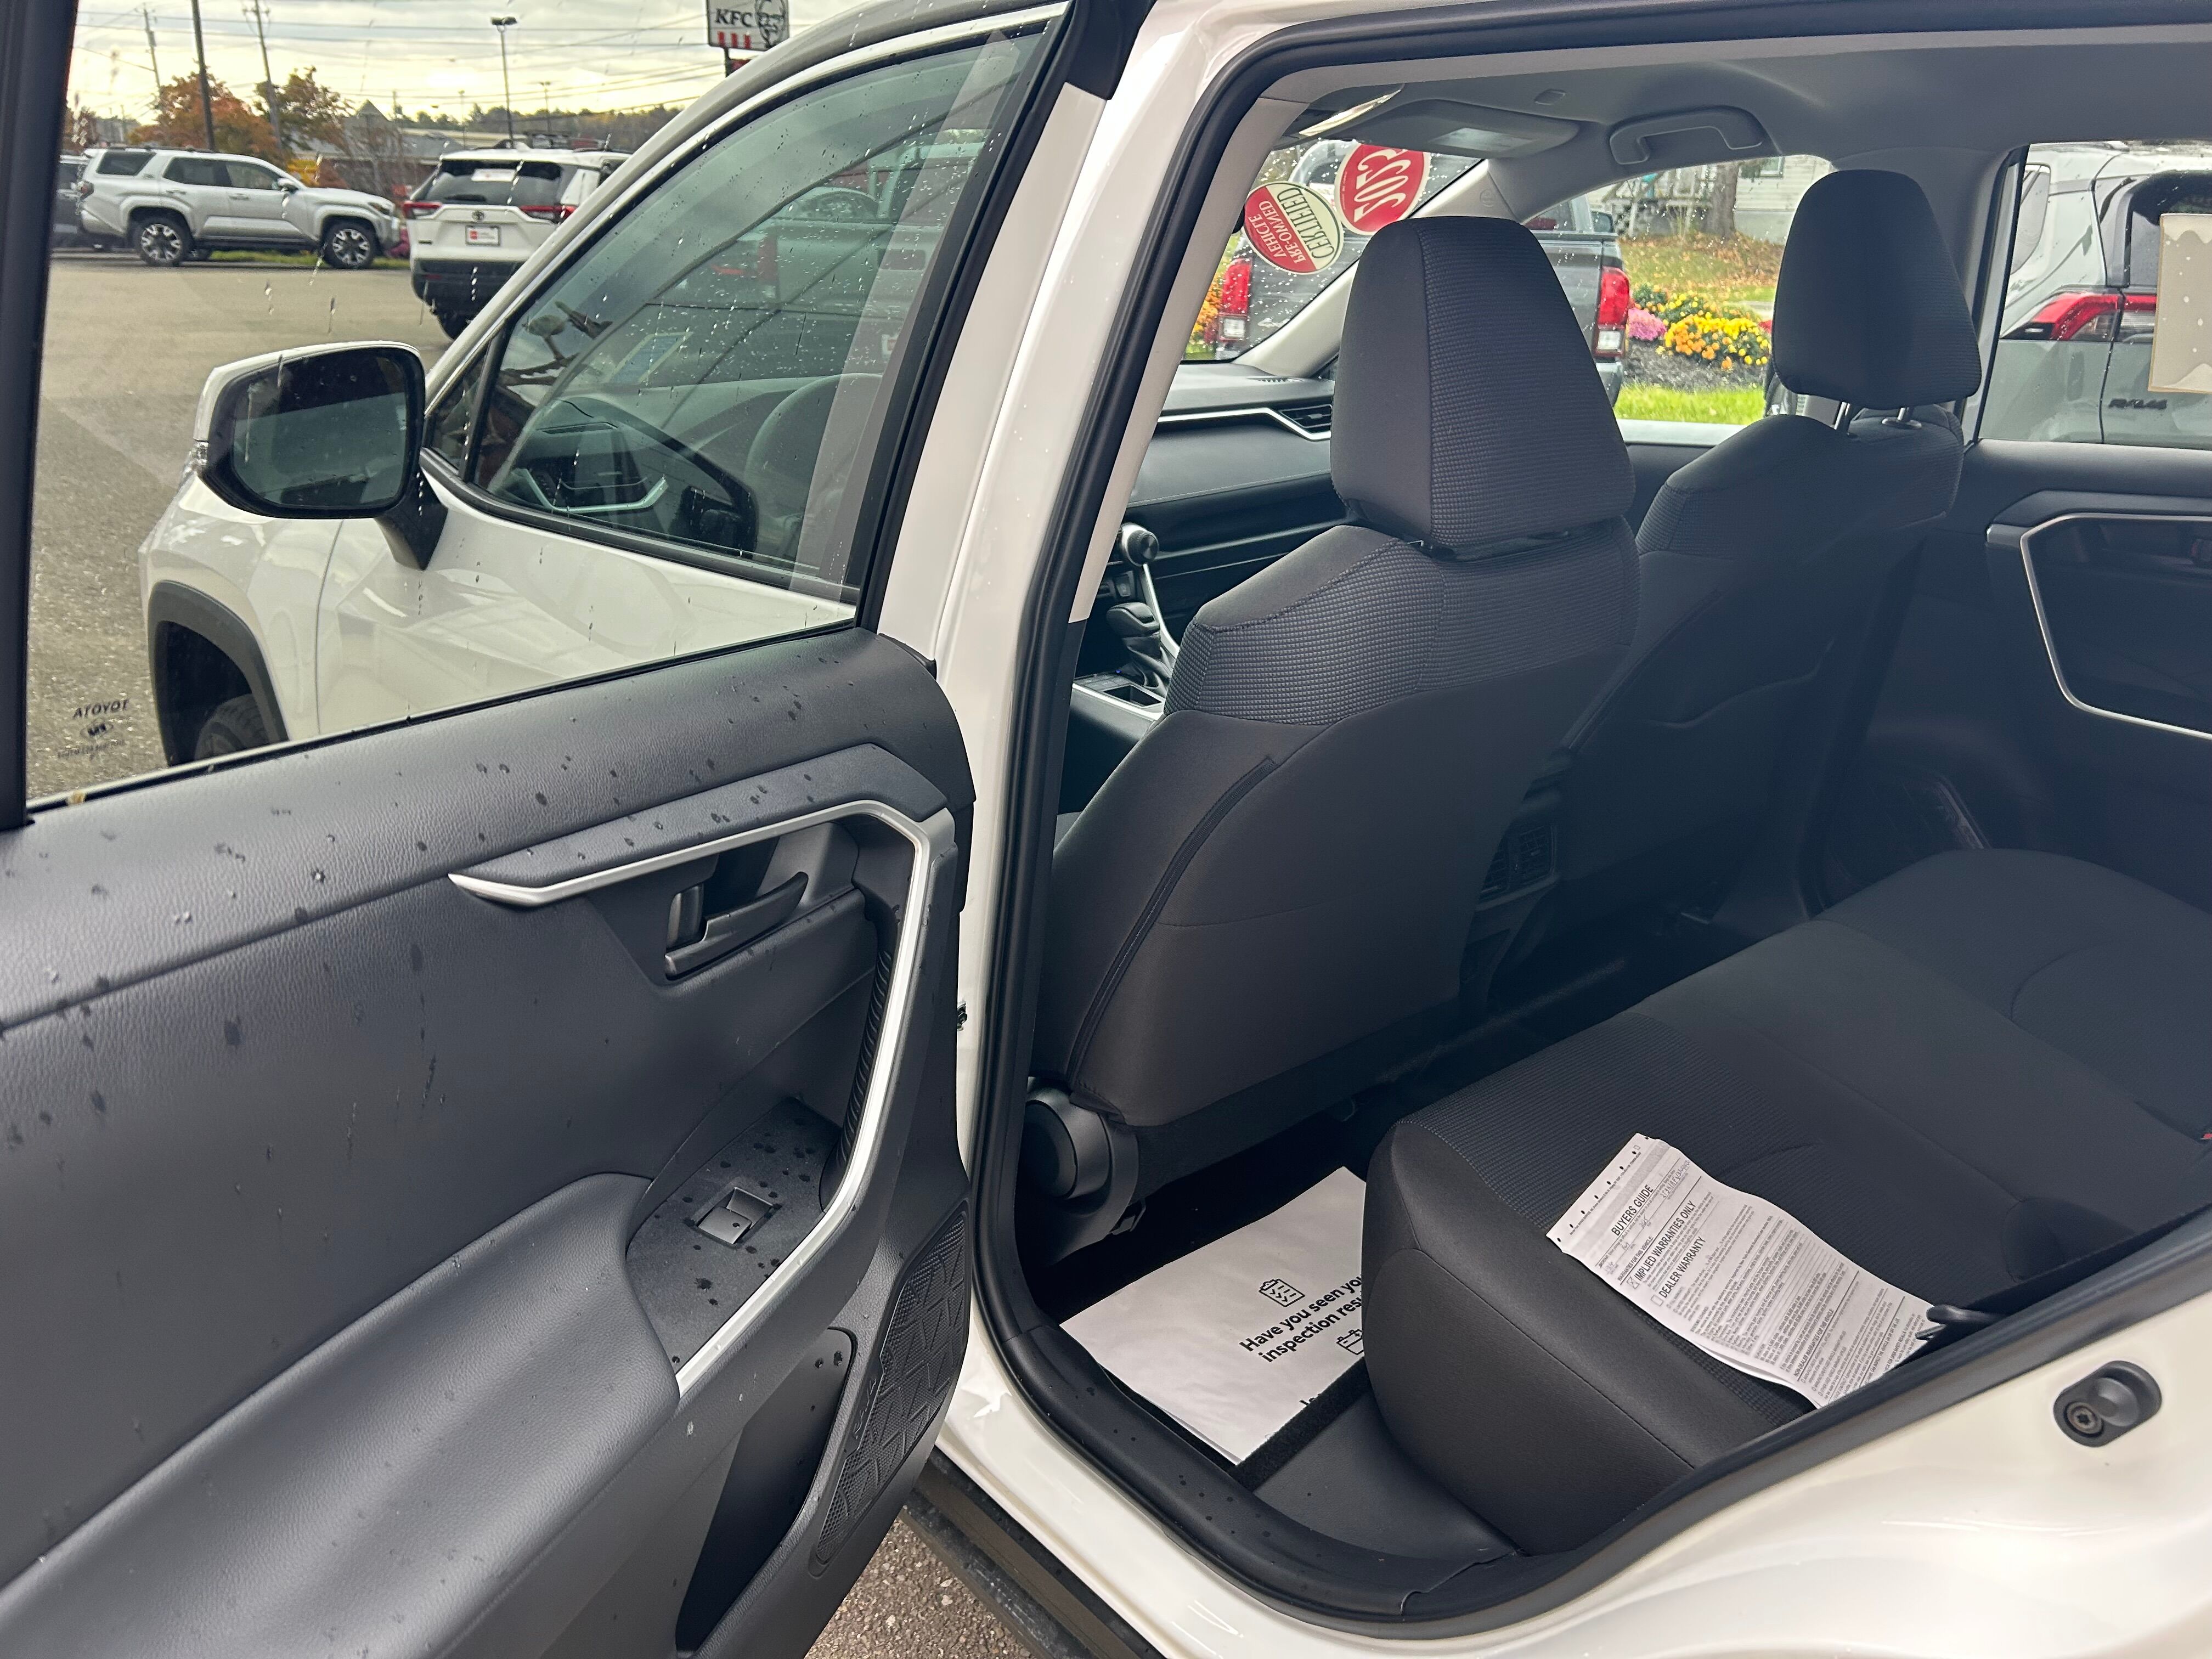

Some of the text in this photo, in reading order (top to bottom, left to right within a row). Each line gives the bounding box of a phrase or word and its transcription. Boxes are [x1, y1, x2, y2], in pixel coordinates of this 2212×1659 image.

[715, 8, 752, 27] KFC
[1611, 1206, 1637, 1236] BUYERS
[1633, 1184, 1654, 1207] GUIDE
[1634, 1255, 1656, 1282] IMPLIED
[1652, 1217, 1684, 1257] WARRANTIES
[1680, 1200, 1696, 1219] ONLY
[1658, 1271, 1683, 1299] DEALER
[1676, 1236, 1706, 1273] WARRANTY
[1239, 1326, 1284, 1352] Have
[1279, 1309, 1312, 1331] you
[1308, 1289, 1345, 1312] seen
[1258, 1313, 1341, 1363] inspection
